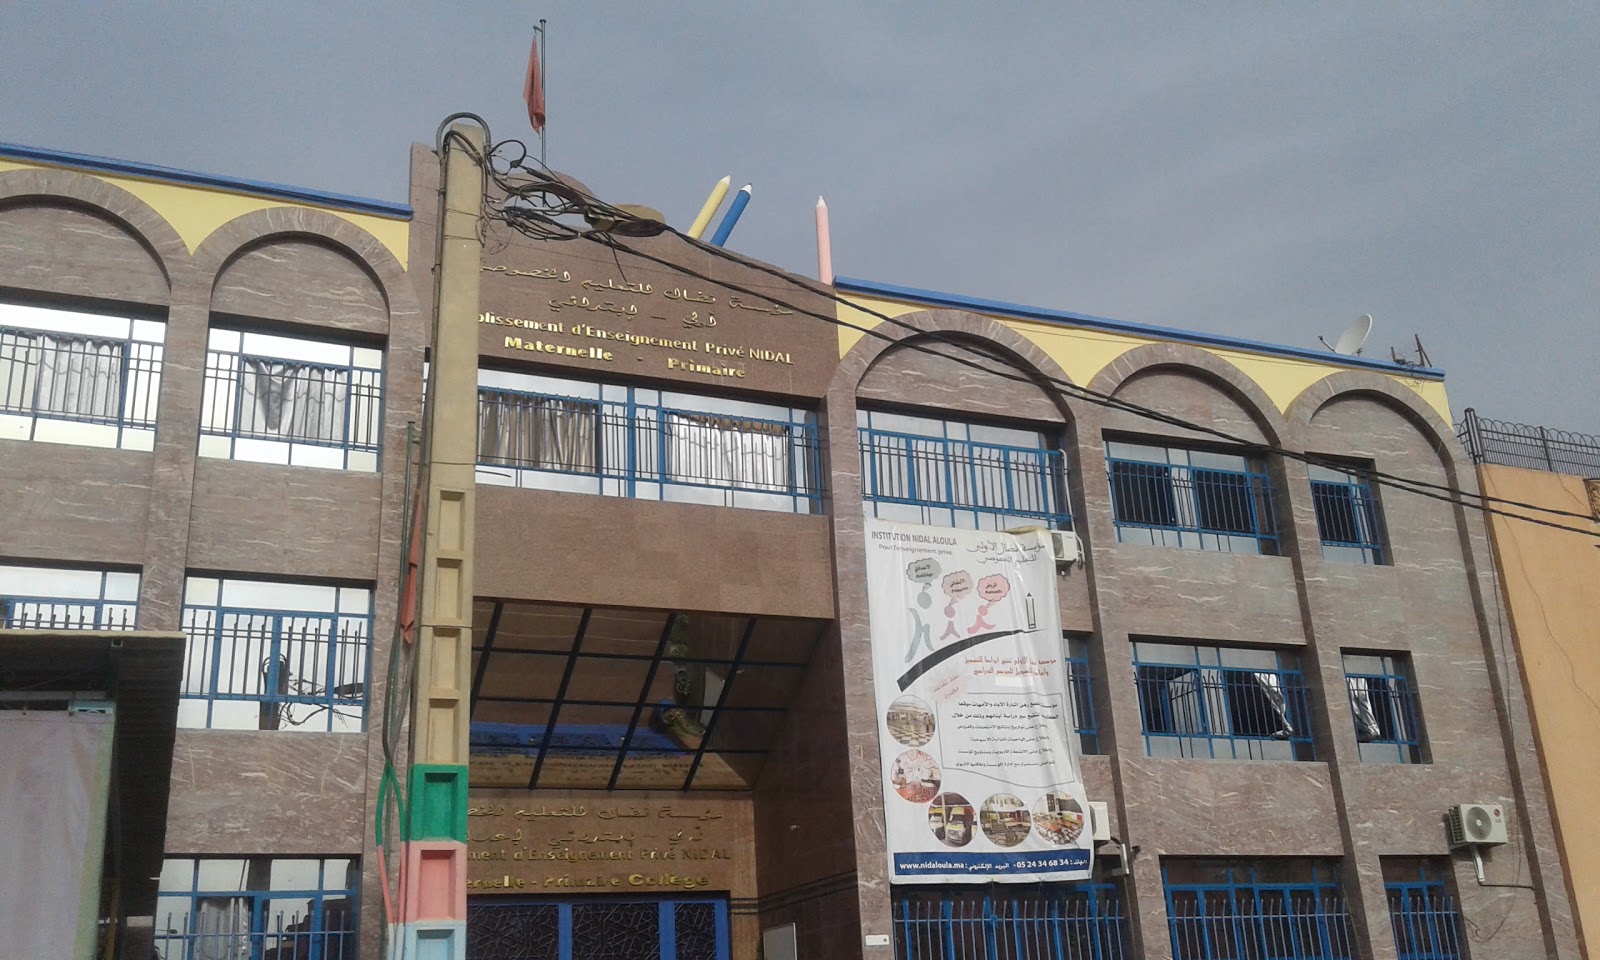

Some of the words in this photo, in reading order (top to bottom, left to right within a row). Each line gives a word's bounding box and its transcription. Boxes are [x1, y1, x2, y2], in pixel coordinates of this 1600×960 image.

[571, 324, 698, 351] d'Enseignement
[705, 341, 745, 358] Privé
[749, 347, 794, 365] NIDAL
[504, 336, 614, 361] Maternelle
[667, 357, 746, 378] Primaire
[871, 531, 911, 542] INSTITUTION
[912, 534, 932, 544] NIDAL
[932, 536, 958, 546] ALOULA
[682, 848, 732, 860] NIDAL
[1048, 859, 1058, 867] 68
[1059, 858, 1069, 866] 34
